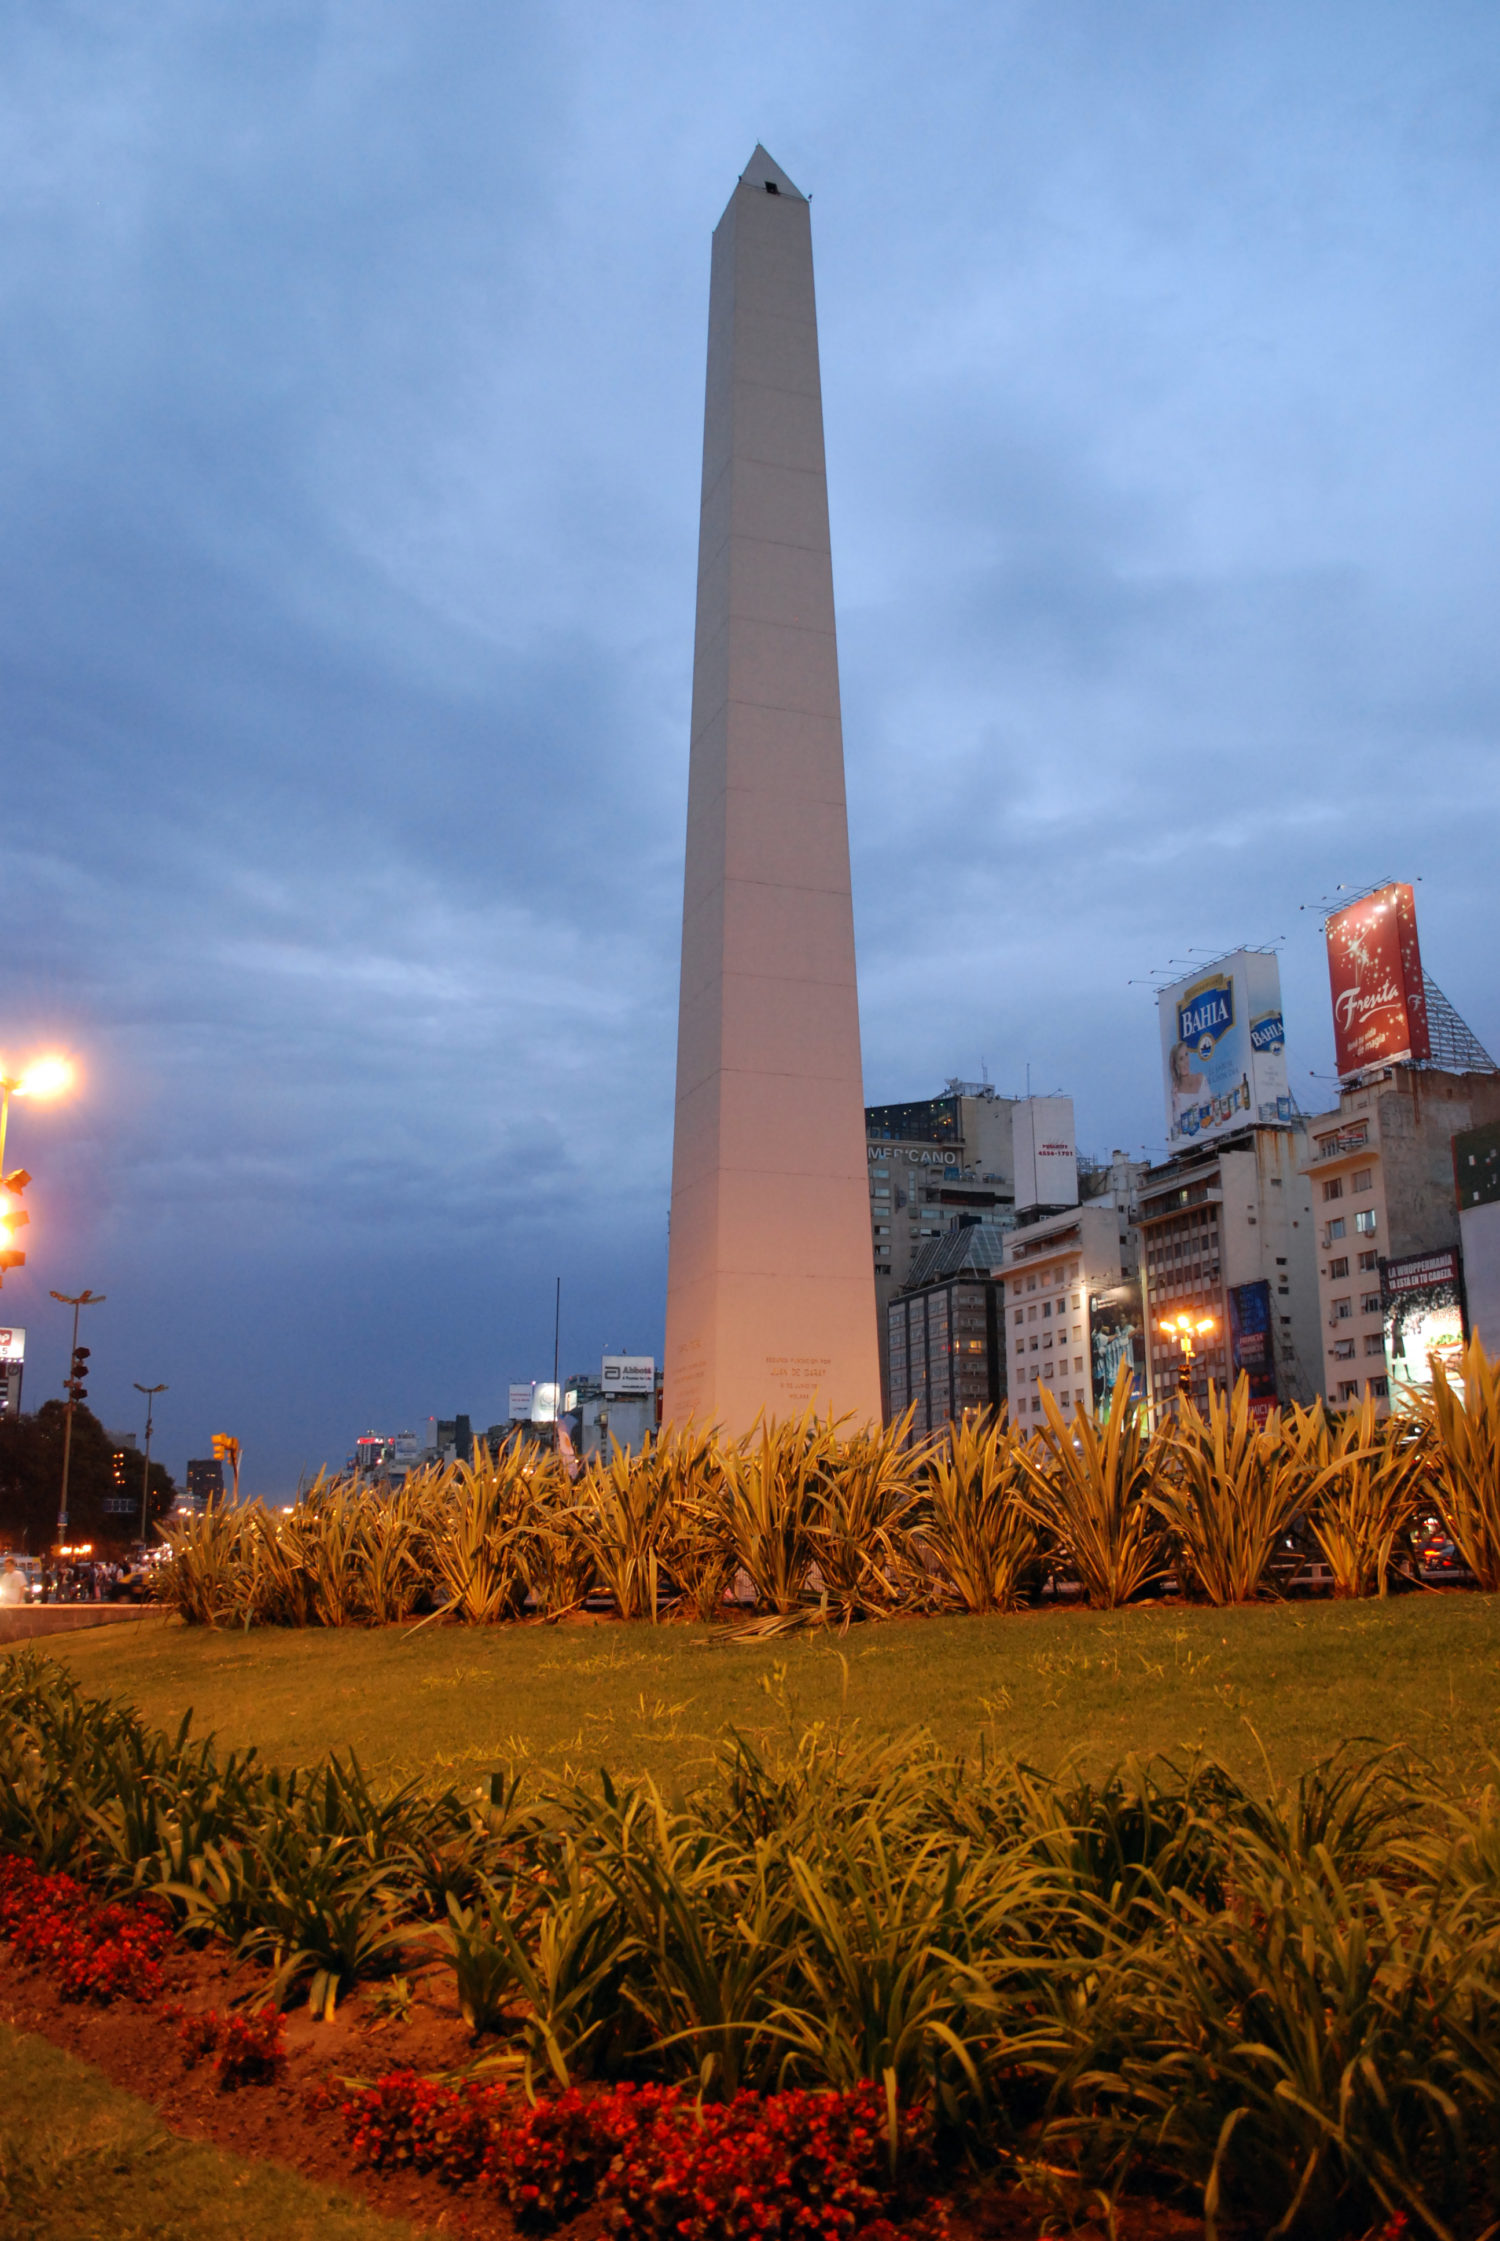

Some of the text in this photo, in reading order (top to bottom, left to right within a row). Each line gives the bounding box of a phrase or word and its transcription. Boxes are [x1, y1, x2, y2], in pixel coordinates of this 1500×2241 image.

[1335, 979, 1399, 1033] Fresita
[1182, 998, 1229, 1039] BAHIA
[1251, 1022, 1284, 1047] BAHIA
[1388, 1266, 1396, 1279] LA
[1389, 1279, 1396, 1290] YA
[1411, 1274, 1419, 1286] EN
[1419, 1273, 1428, 1284] TU
[623, 1366, 652, 1374] Abbott
[791, 1368, 800, 1377] DE
